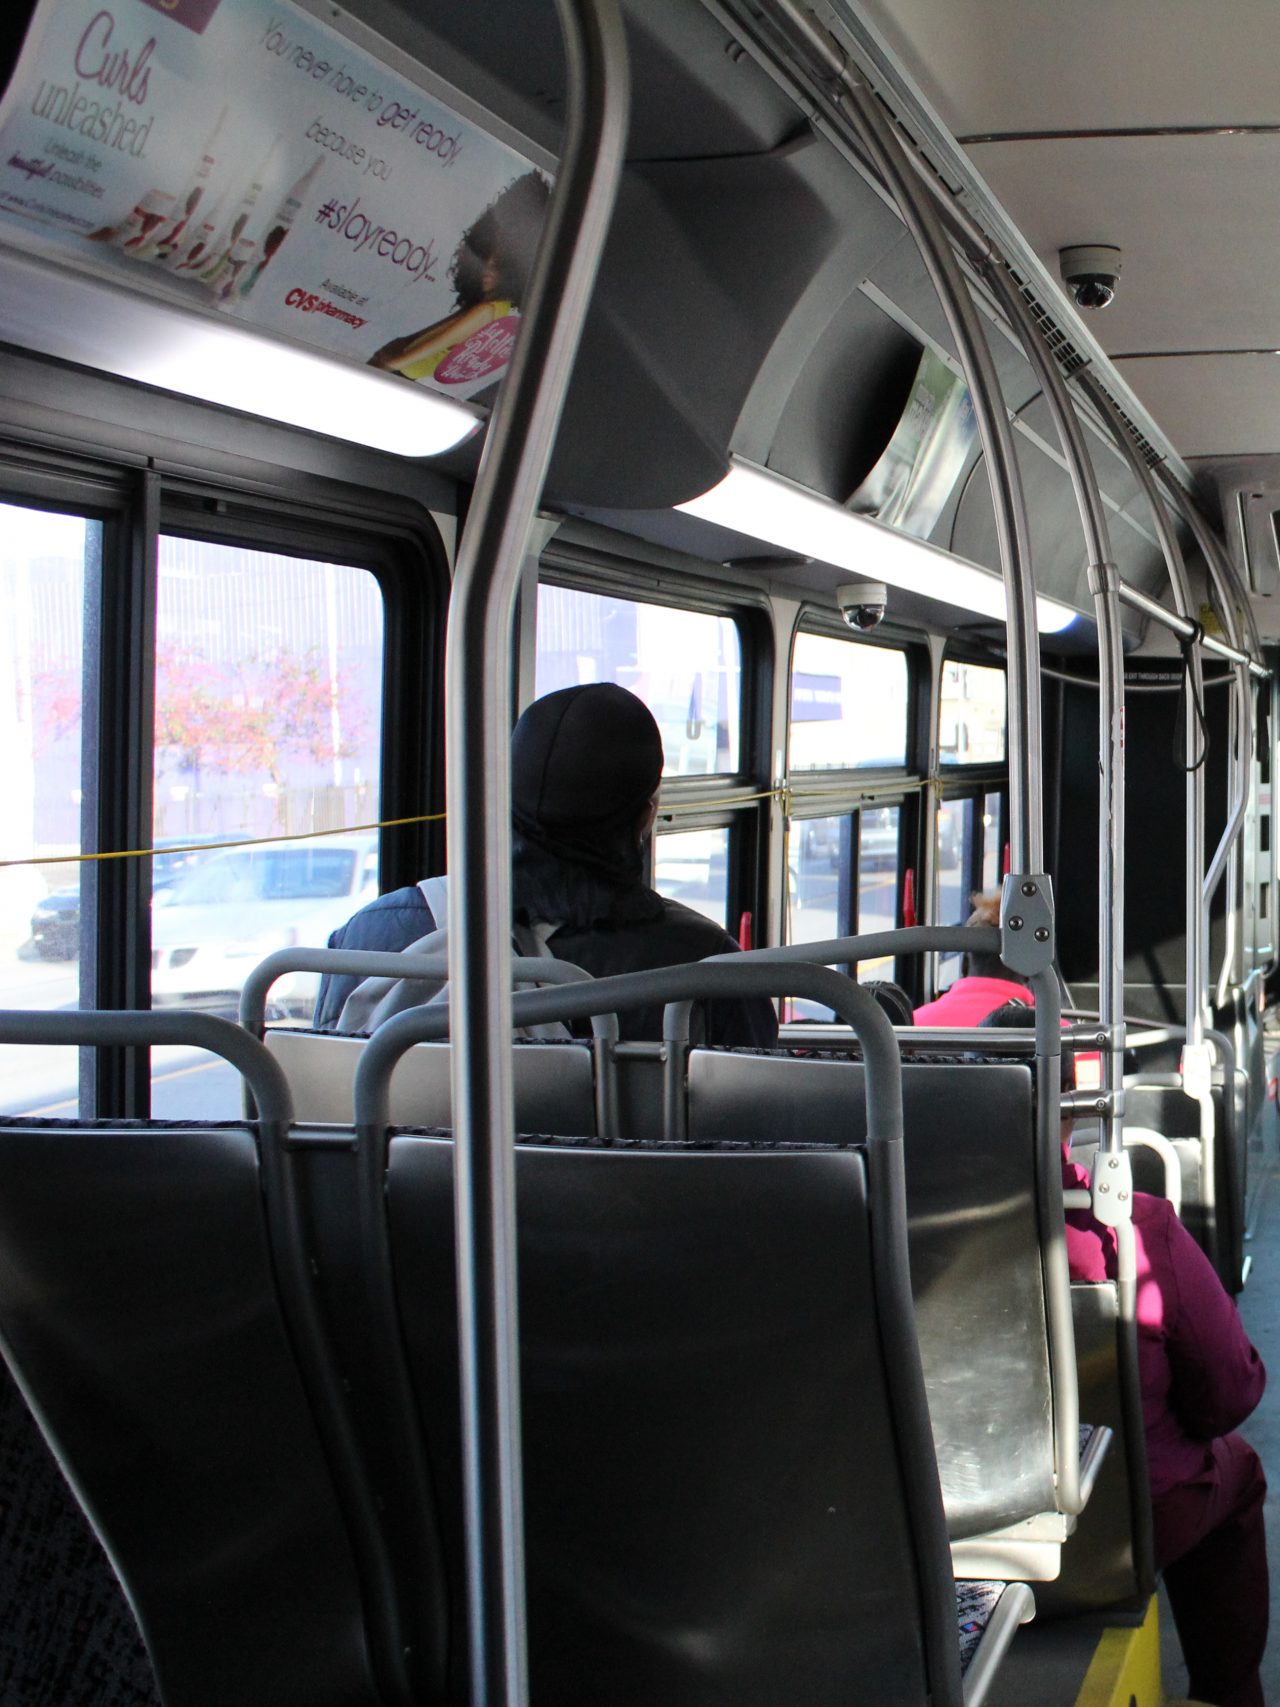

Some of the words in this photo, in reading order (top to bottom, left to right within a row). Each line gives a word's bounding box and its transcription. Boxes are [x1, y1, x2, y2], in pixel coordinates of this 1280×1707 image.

[75, 10, 156, 105] Curls
[262, 16, 290, 56] You
[288, 45, 332, 80] never
[328, 64, 368, 102] have
[364, 88, 384, 112] to
[376, 101, 420, 133] get
[305, 115, 366, 166] because
[362, 154, 393, 182] you
